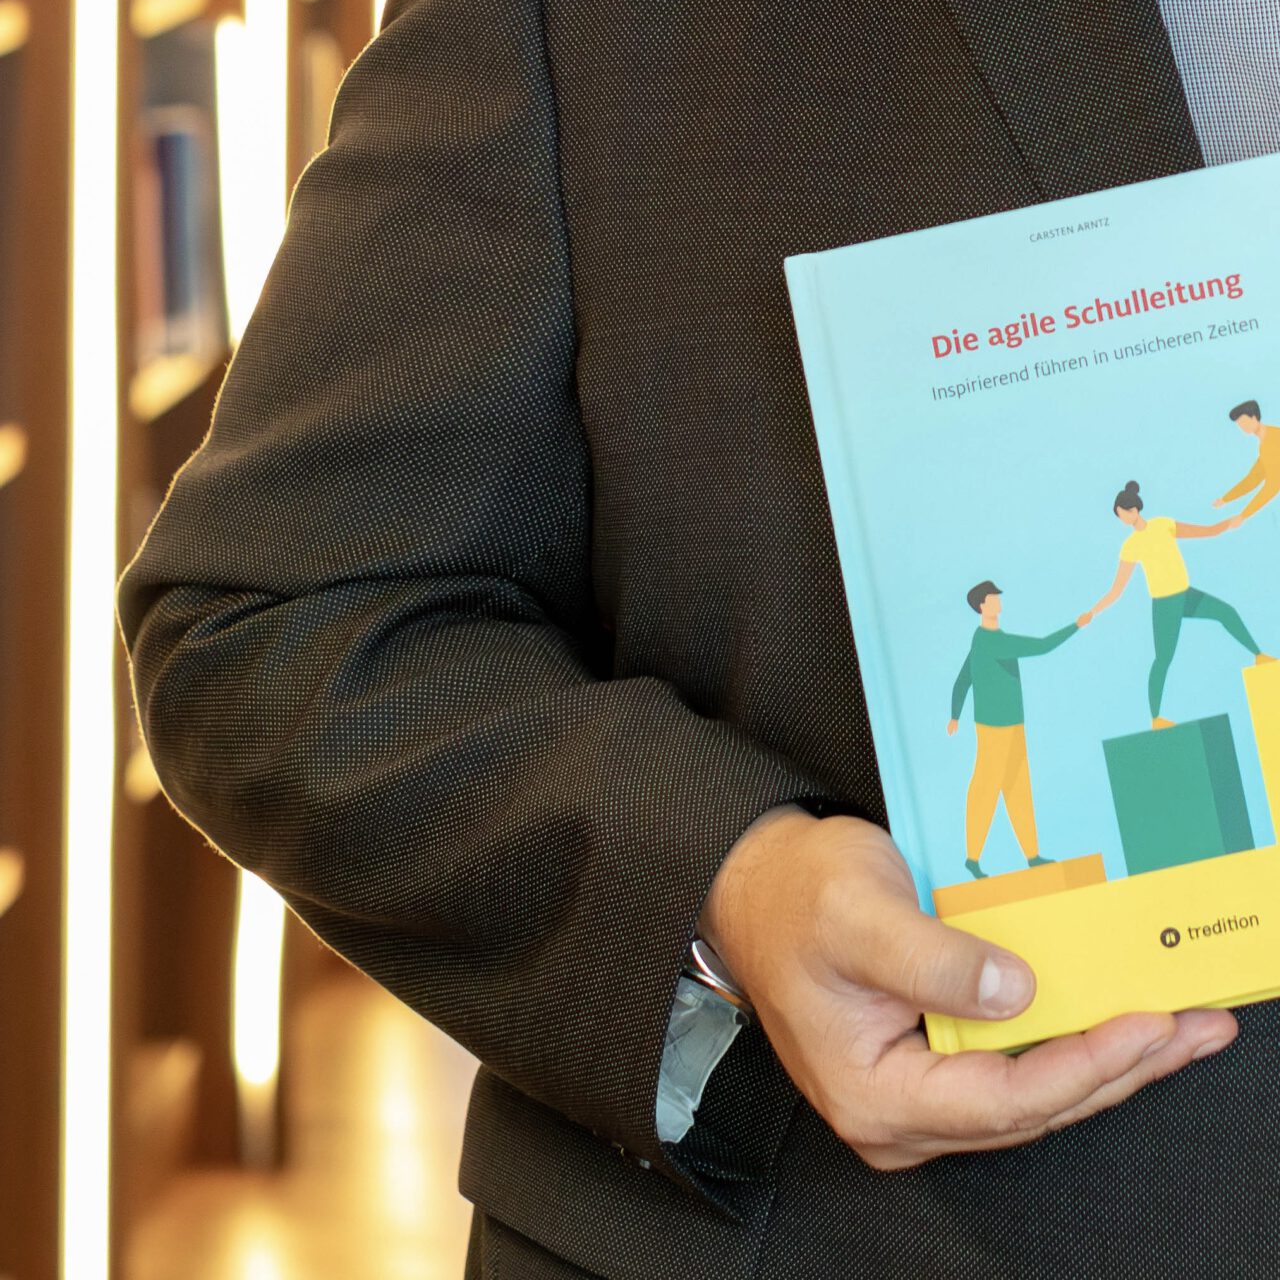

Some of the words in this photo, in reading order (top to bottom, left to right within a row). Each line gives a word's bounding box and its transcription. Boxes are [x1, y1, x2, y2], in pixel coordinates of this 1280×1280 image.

[1029, 224, 1075, 243] CARSTEN
[1077, 217, 1110, 234] ARNTZ
[931, 329, 979, 359] Die
[988, 311, 1056, 349] agile
[1063, 273, 1244, 330] Schulleitung
[932, 365, 1029, 401] Inspirierend
[1034, 352, 1089, 379] führen
[1093, 349, 1109, 366] in
[1113, 328, 1203, 361] unsicheren
[1208, 317, 1260, 341] Zeiten
[1187, 914, 1260, 940] tredition
